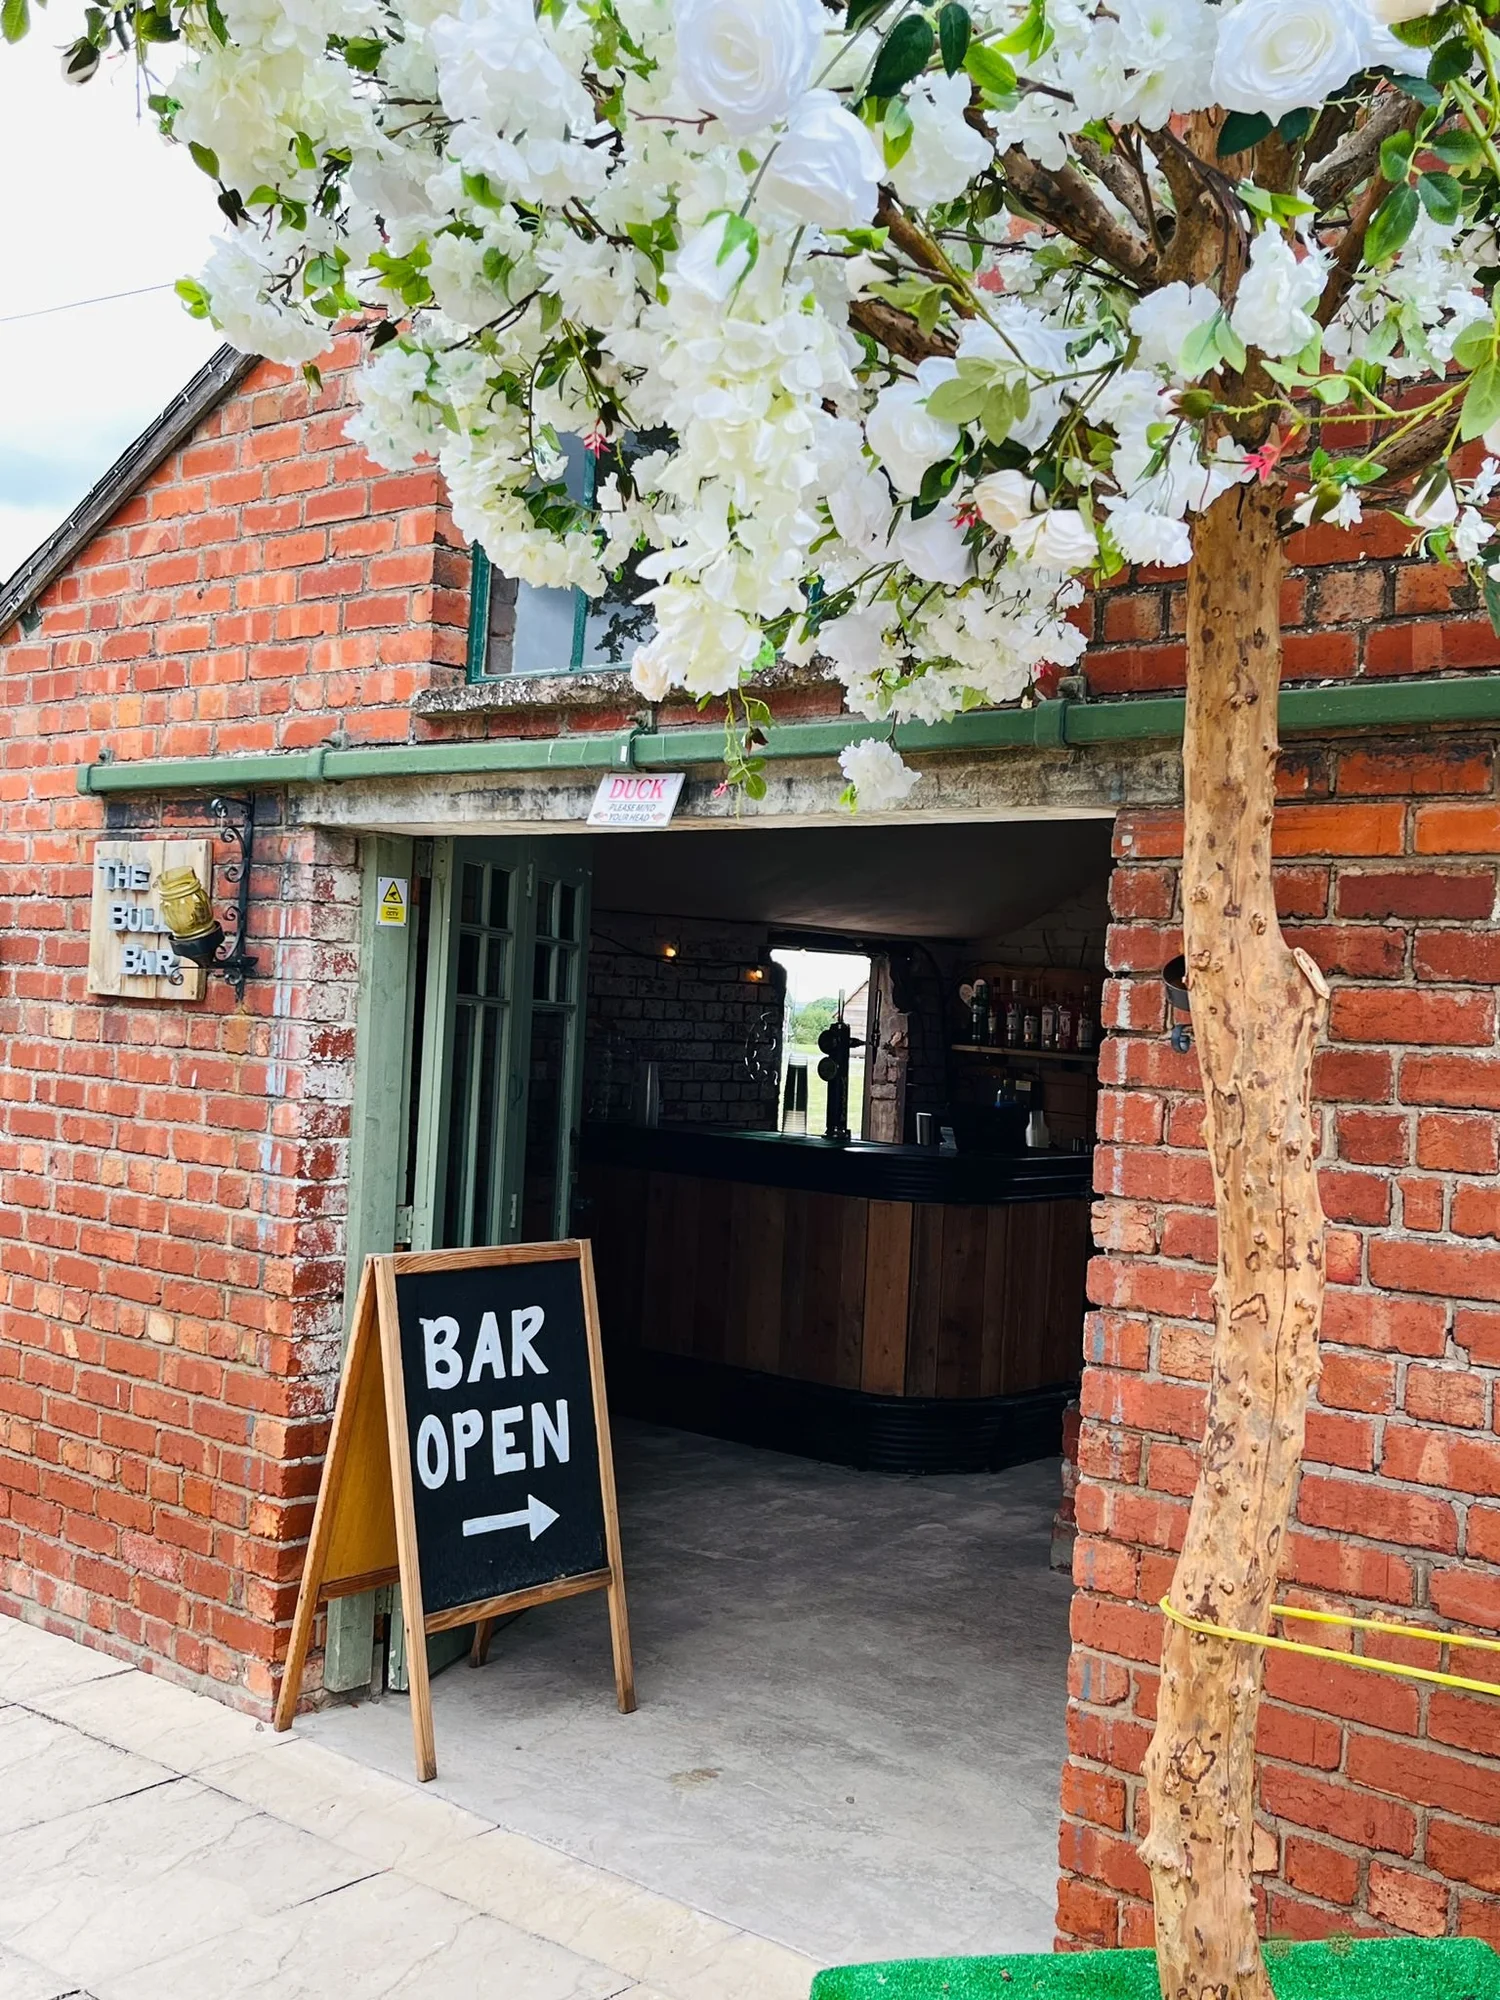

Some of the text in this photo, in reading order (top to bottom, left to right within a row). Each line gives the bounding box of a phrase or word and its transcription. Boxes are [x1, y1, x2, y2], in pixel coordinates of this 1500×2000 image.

[609, 778, 667, 799] DUCK
[608, 813, 650, 821] YOUR HEAD
[609, 803, 657, 812] PLEASE MIND
[98, 858, 151, 891] THE
[120, 943, 179, 976] BAR
[419, 1305, 549, 1390] BAR
[416, 1399, 570, 1490] OPEN
